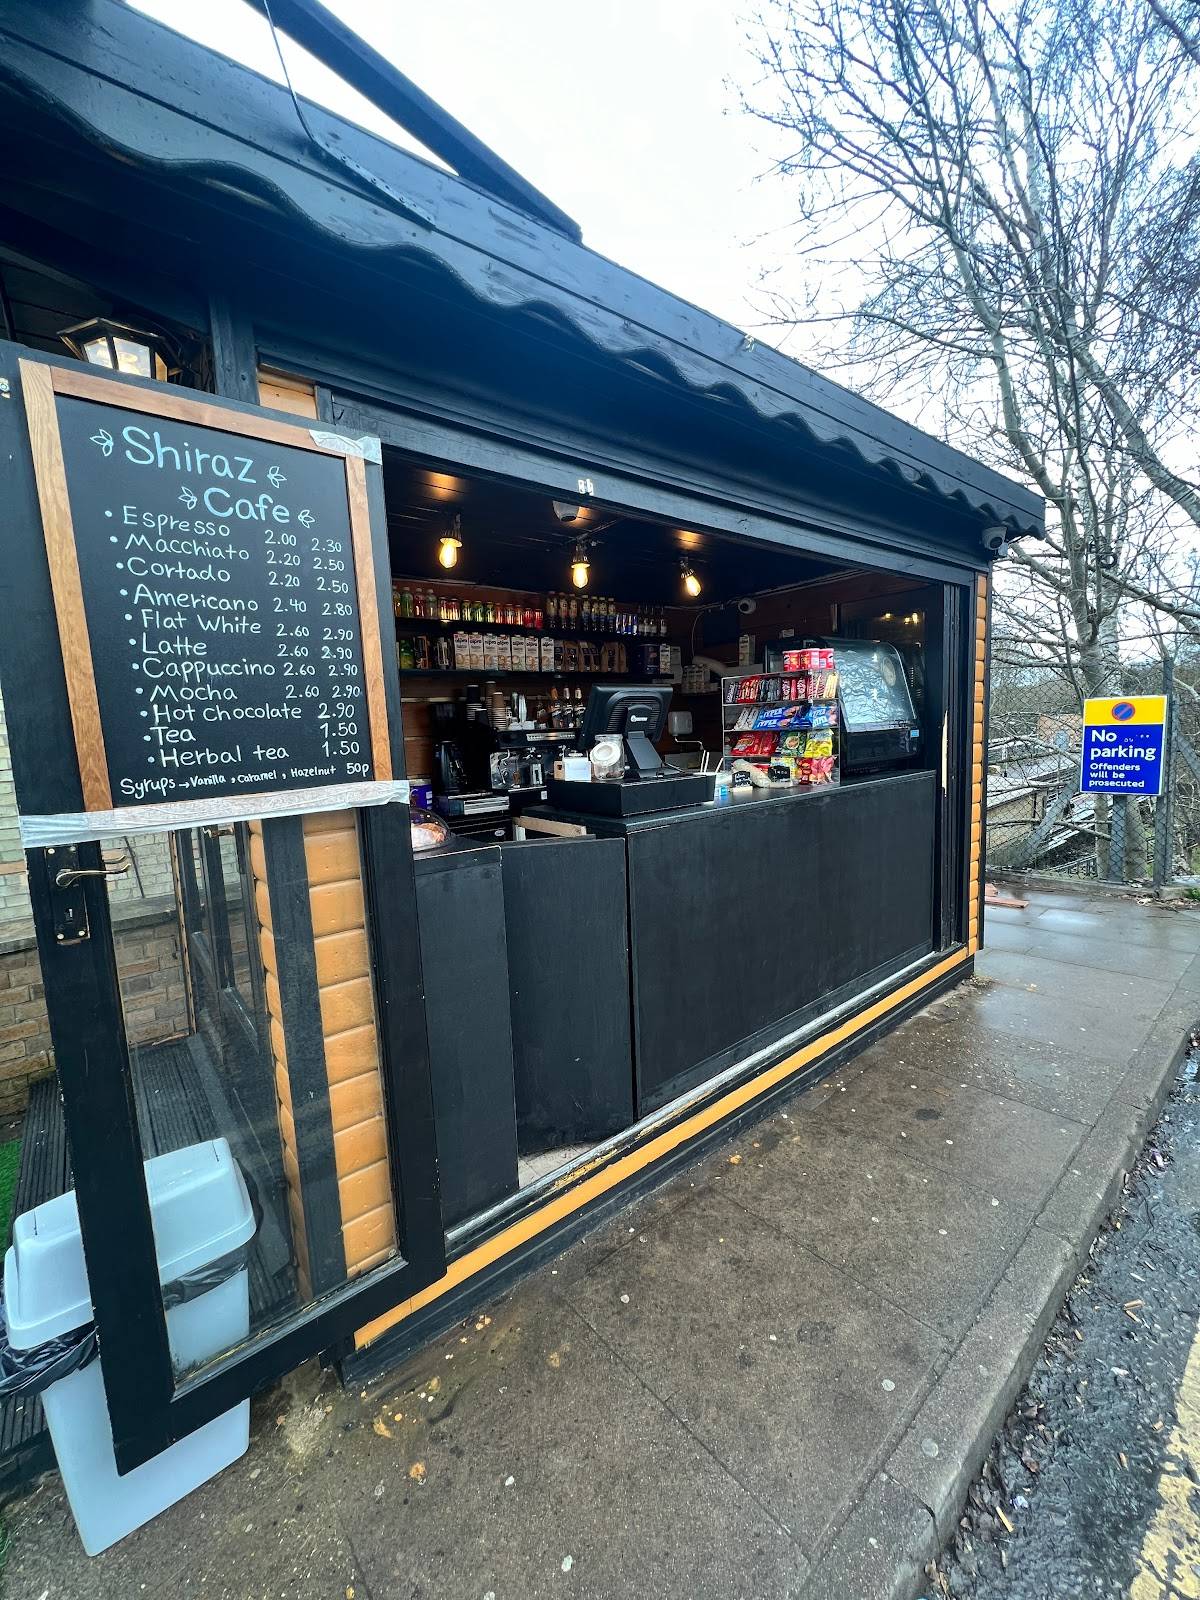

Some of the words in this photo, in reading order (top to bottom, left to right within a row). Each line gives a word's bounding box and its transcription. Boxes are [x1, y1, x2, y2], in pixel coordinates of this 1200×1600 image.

[122, 426, 256, 483] Shiraz
[204, 488, 289, 523] Cafe
[123, 505, 230, 536] Espresso
[265, 530, 296, 546] 2.00
[312, 538, 341, 552] 2.30
[125, 534, 249, 559] Macchiato
[267, 550, 300, 565] 2.20
[313, 557, 344, 571] 2.50
[127, 557, 230, 582] Cortado
[269, 571, 300, 587] 2.20
[317, 577, 348, 593] 2.50
[134, 584, 258, 611] Americano
[273, 597, 306, 612] 2.40
[322, 603, 352, 616] 2.80
[141, 609, 187, 629] Flat
[197, 615, 261, 634] White
[276, 624, 309, 637] 2.60
[323, 628, 353, 640] 2.90
[143, 632, 207, 656] Latte
[277, 644, 308, 657] 2.60
[321, 646, 352, 659] 2.90
[143, 658, 275, 683] Cappuccino
[284, 662, 315, 676] 2.60
[329, 664, 357, 676] 2.90
[150, 684, 237, 702] Mocha
[286, 685, 319, 698] 2.60
[332, 685, 360, 698] 2.90
[153, 704, 195, 726] Hot
[318, 703, 354, 719] 2.90
[150, 726, 196, 746] Tea
[320, 722, 357, 738] 1.50
[1092, 730, 1117, 742] No
[160, 745, 241, 767] Herbal
[253, 745, 289, 760] tea
[322, 741, 359, 757] 1.50
[1091, 745, 1156, 761] parking
[1090, 763, 1140, 771] Offenders
[120, 778, 175, 799] Syrups
[291, 765, 336, 777] Hazelnut
[347, 763, 368, 776] 50p
